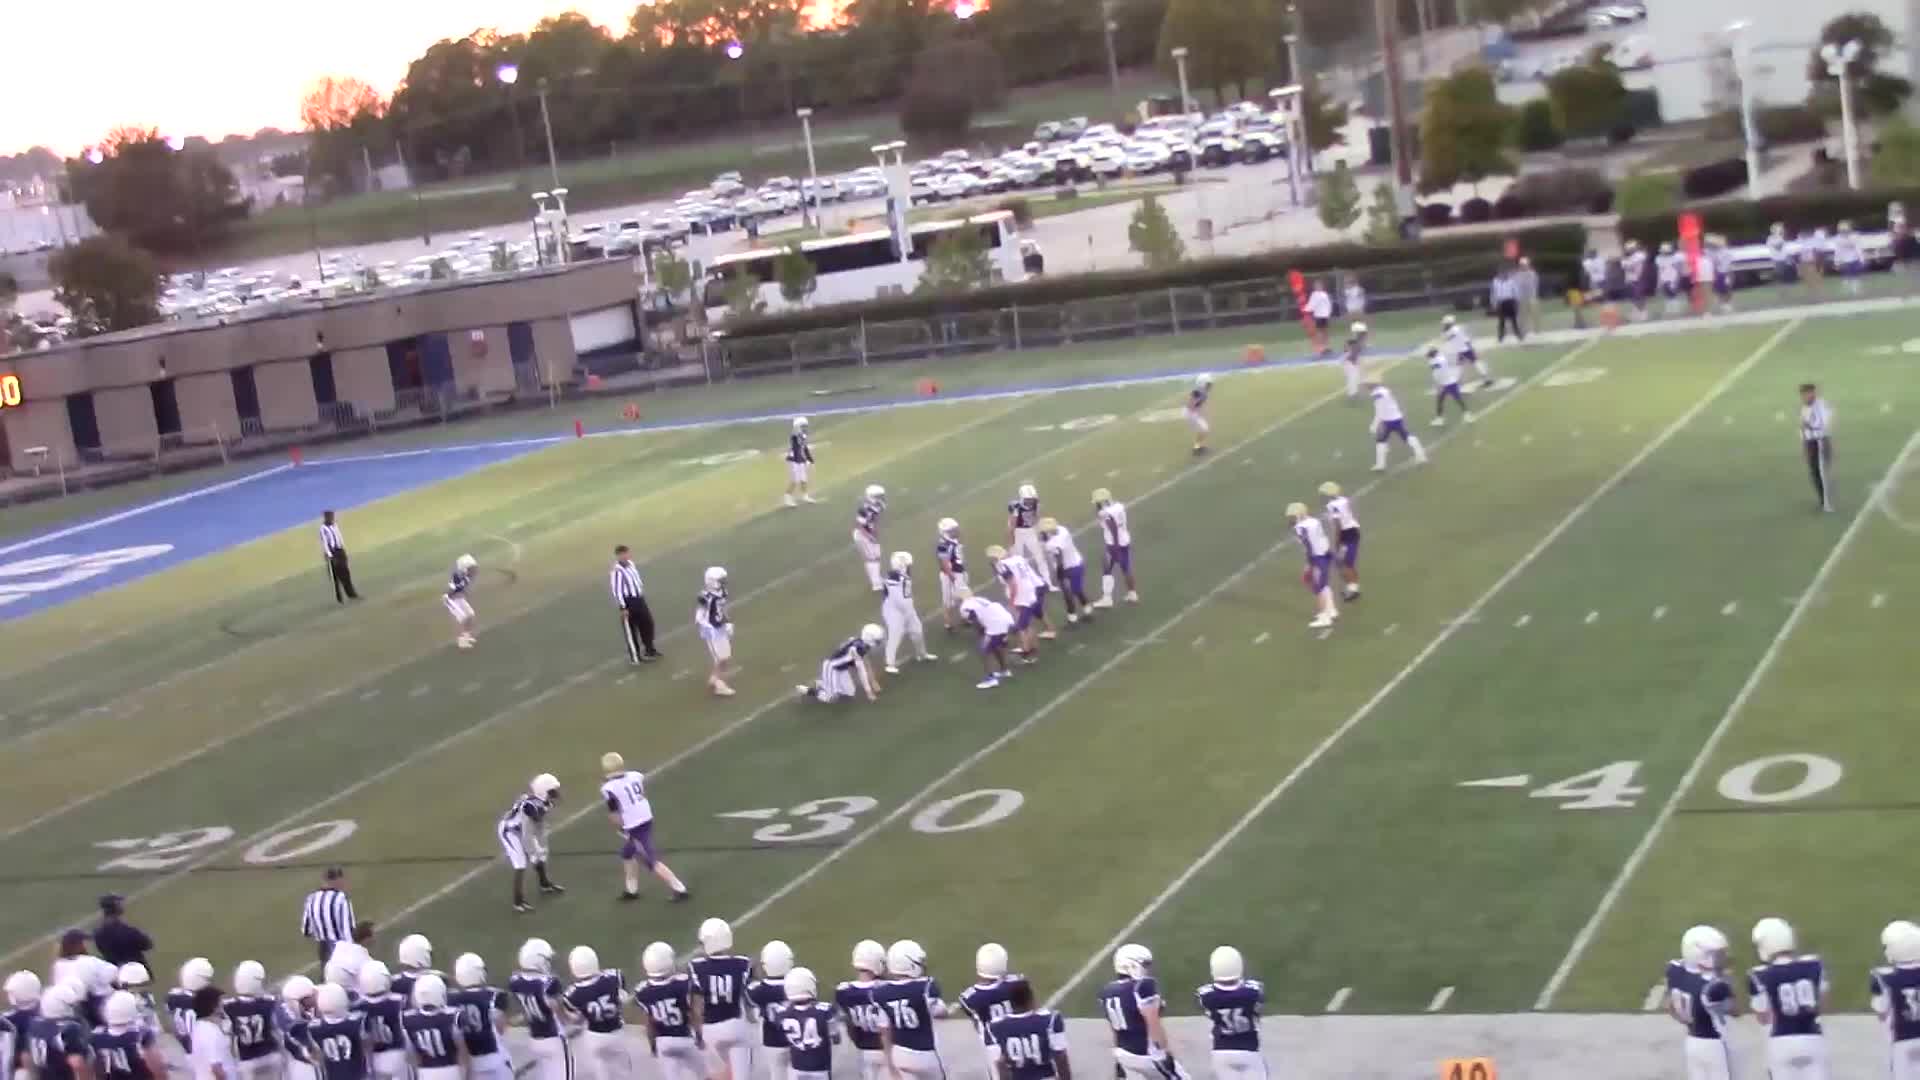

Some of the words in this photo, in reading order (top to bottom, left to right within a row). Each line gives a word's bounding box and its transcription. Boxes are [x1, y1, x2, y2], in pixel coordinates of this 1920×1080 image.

[0, 375, 21, 408] 0
[624, 782, 642, 805] 19
[1528, 753, 1843, 810] 40
[752, 796, 1025, 842] 30
[709, 974, 733, 1005] 14
[650, 998, 684, 1026] 45
[886, 998, 920, 1029] 76
[782, 1017, 822, 1050] 24
[1006, 1033, 1042, 1068] 94
